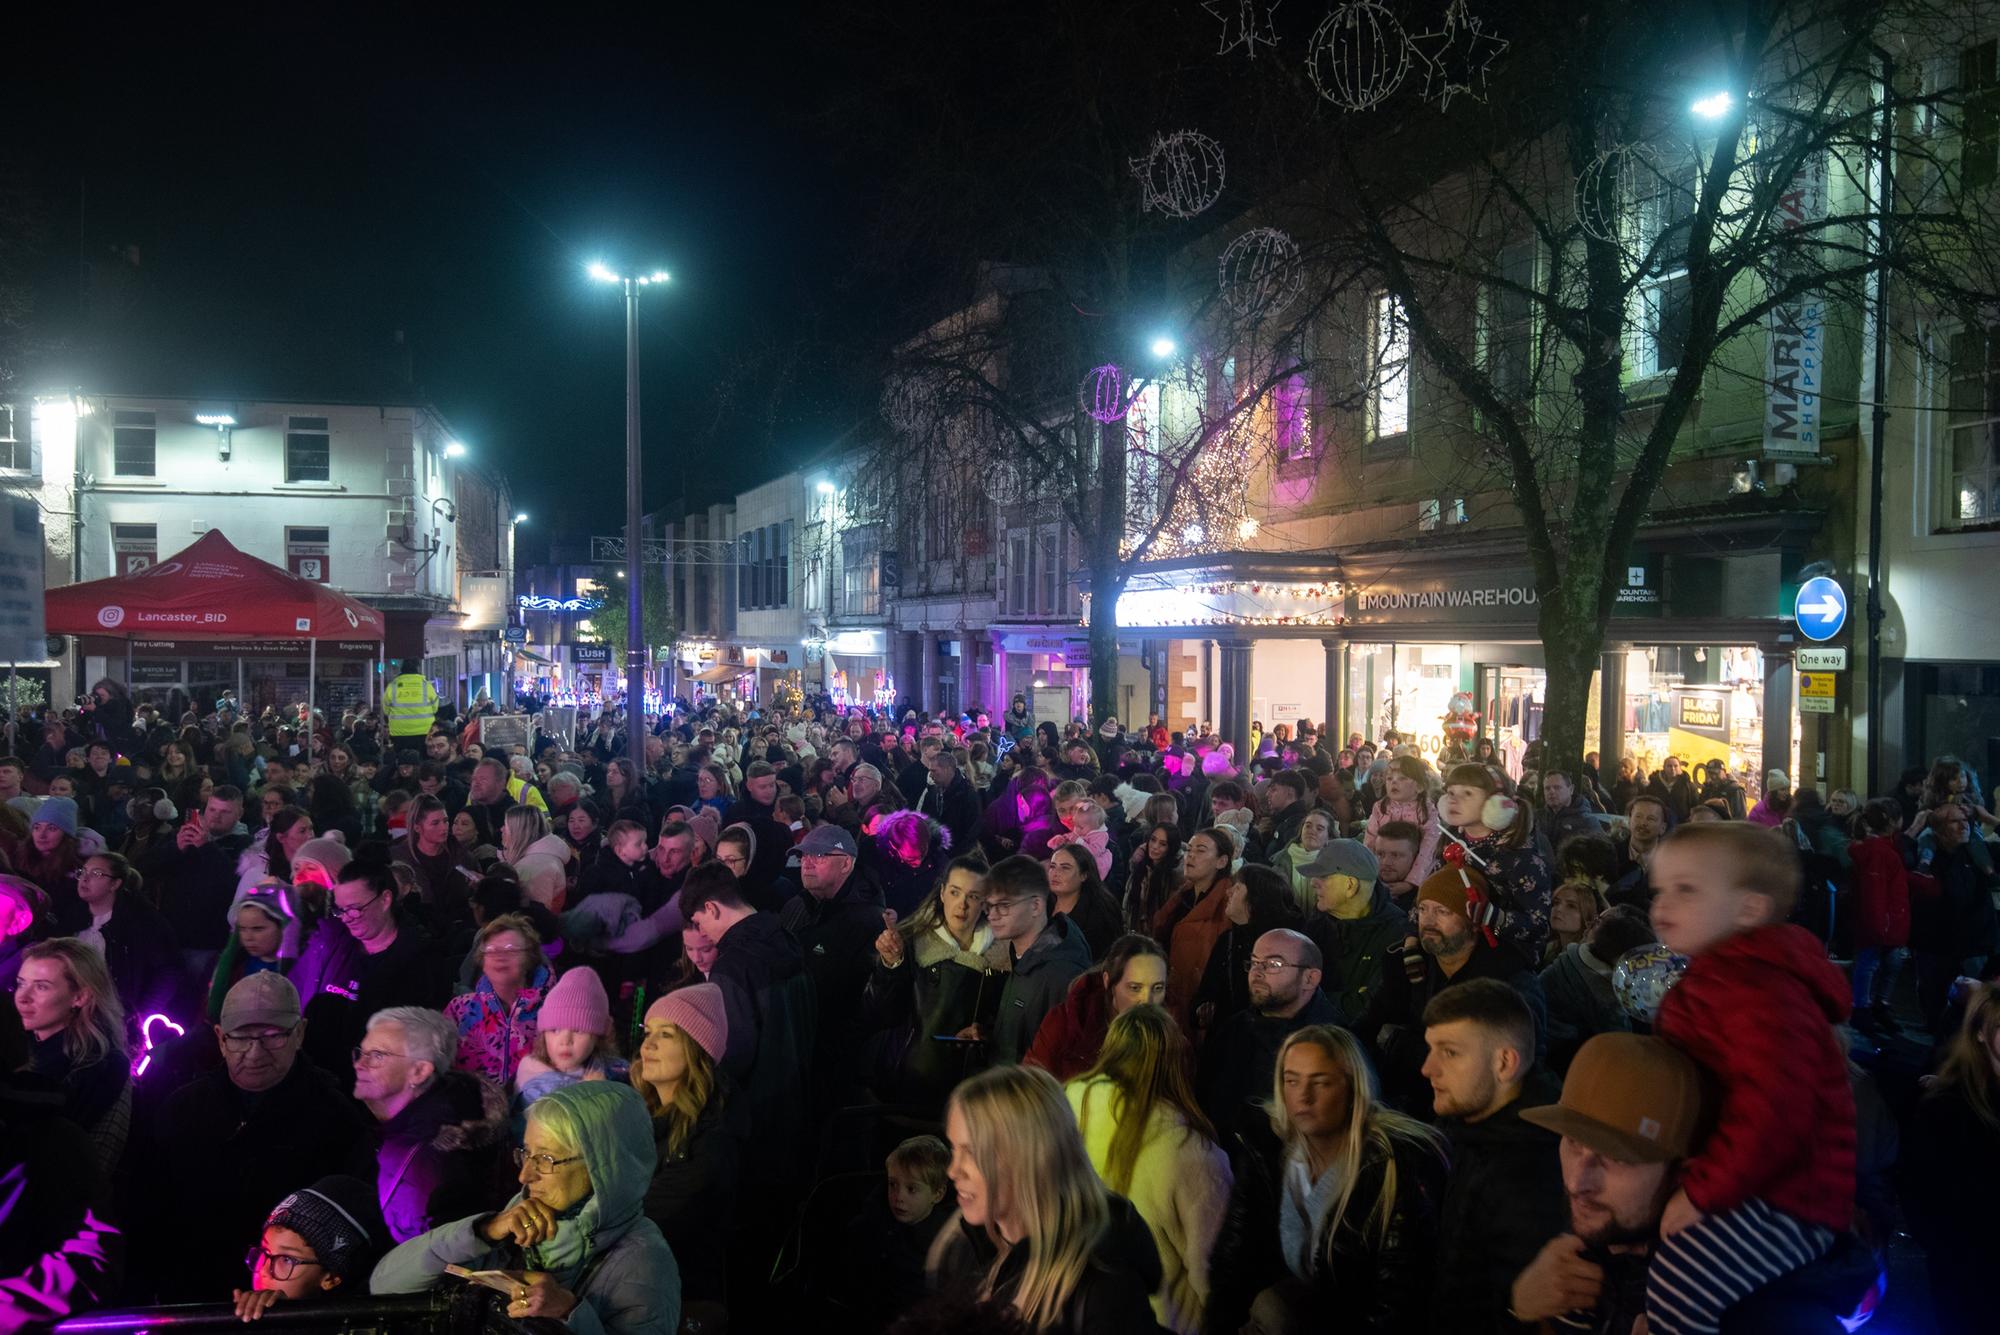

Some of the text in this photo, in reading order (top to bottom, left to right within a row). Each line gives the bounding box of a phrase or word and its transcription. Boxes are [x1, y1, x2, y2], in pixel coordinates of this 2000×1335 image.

[1367, 587, 1539, 610] MOUNTAIN WAREHOU
[138, 612, 227, 624] Lancaster_BID
[339, 643, 373, 651] Engraving
[1800, 654, 1842, 666] One way
[1683, 698, 1718, 713] BLACK
[1683, 711, 1720, 725] FRIDAY
